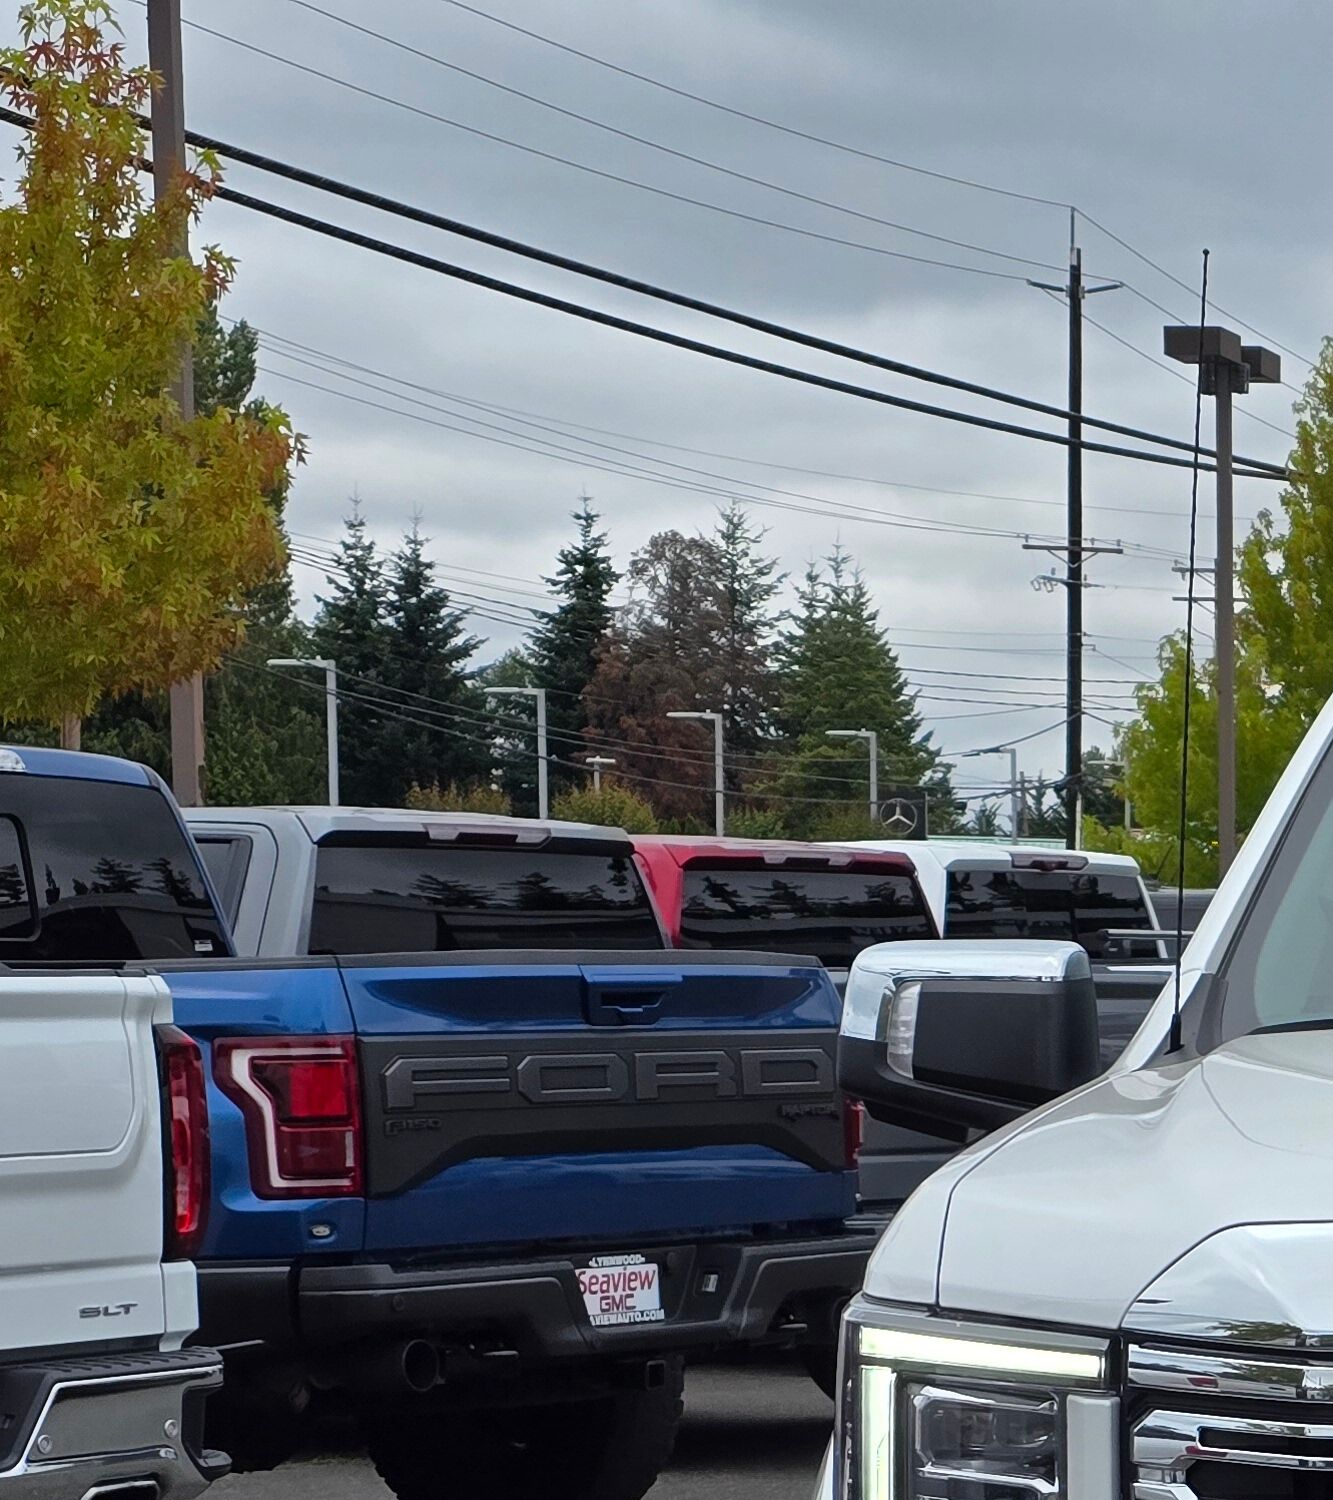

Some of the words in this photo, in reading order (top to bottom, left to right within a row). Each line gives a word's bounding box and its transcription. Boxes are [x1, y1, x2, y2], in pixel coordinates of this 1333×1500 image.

[381, 1047, 836, 1112] FORD
[578, 1266, 656, 1296] Seaview
[79, 1303, 138, 1319] SLT
[600, 1294, 636, 1313] GMC
